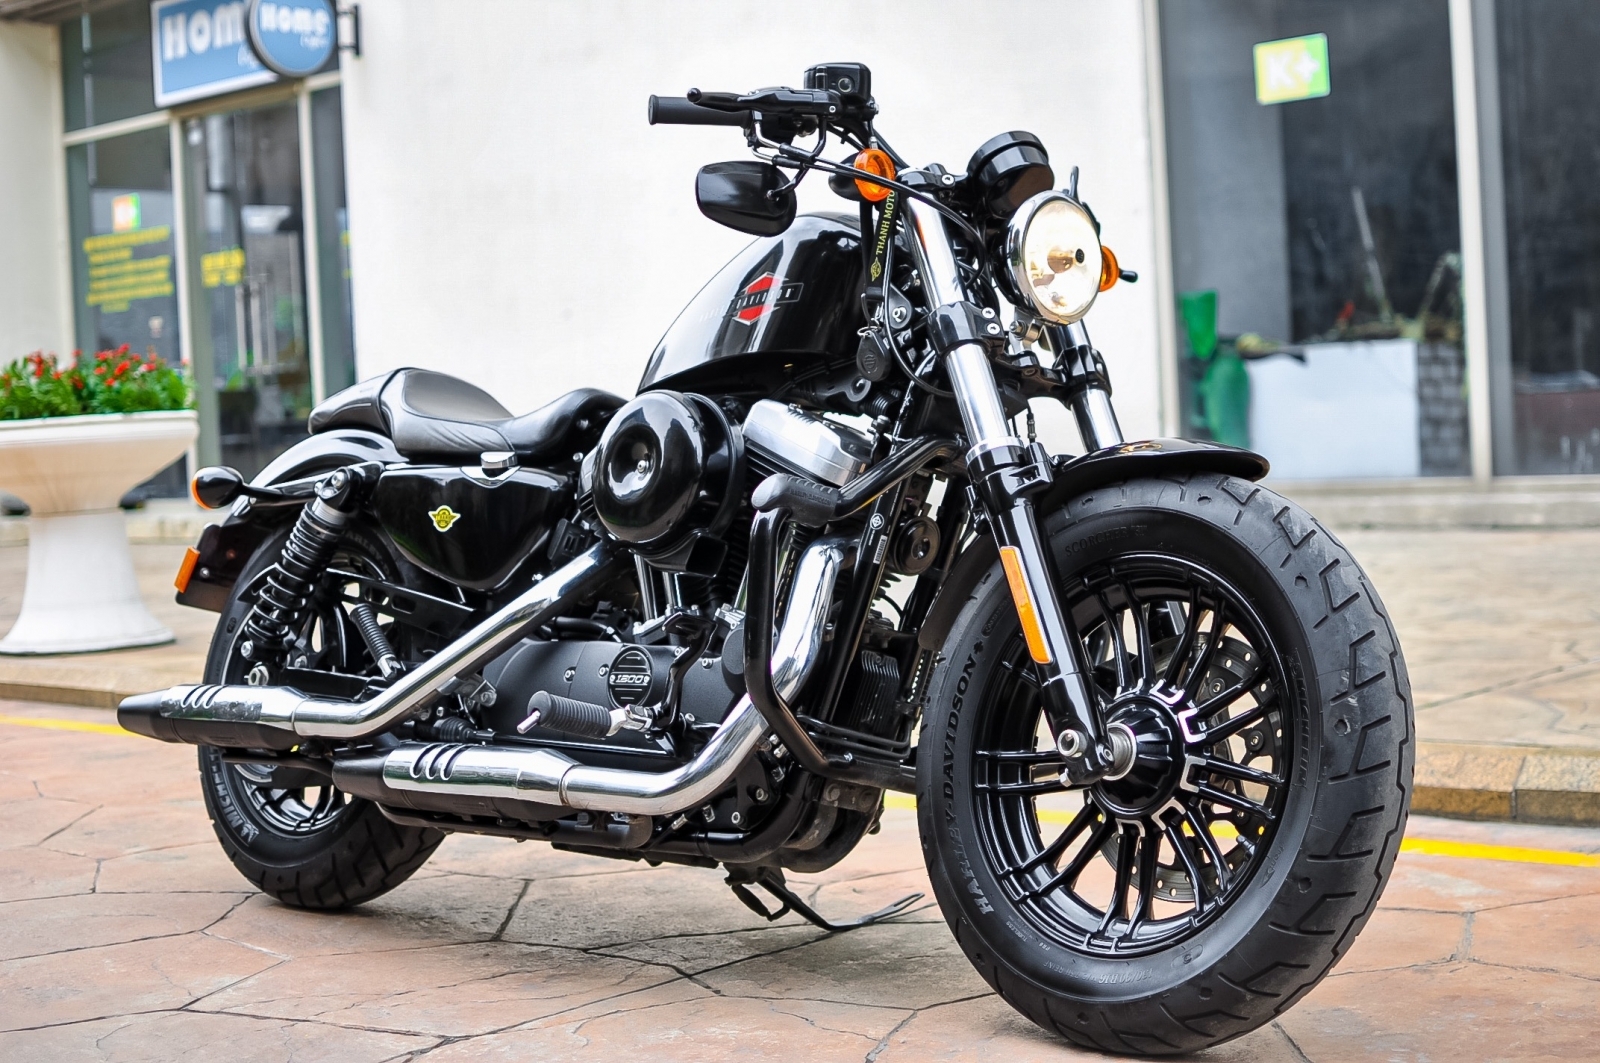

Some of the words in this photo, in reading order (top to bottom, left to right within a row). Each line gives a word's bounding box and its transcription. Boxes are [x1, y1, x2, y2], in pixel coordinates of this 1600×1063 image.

[875, 219, 891, 256] THANH
[883, 189, 896, 219] MOTO
[615, 674, 644, 684] 1200
[942, 653, 995, 915] HARLEY-DAVIDSON
